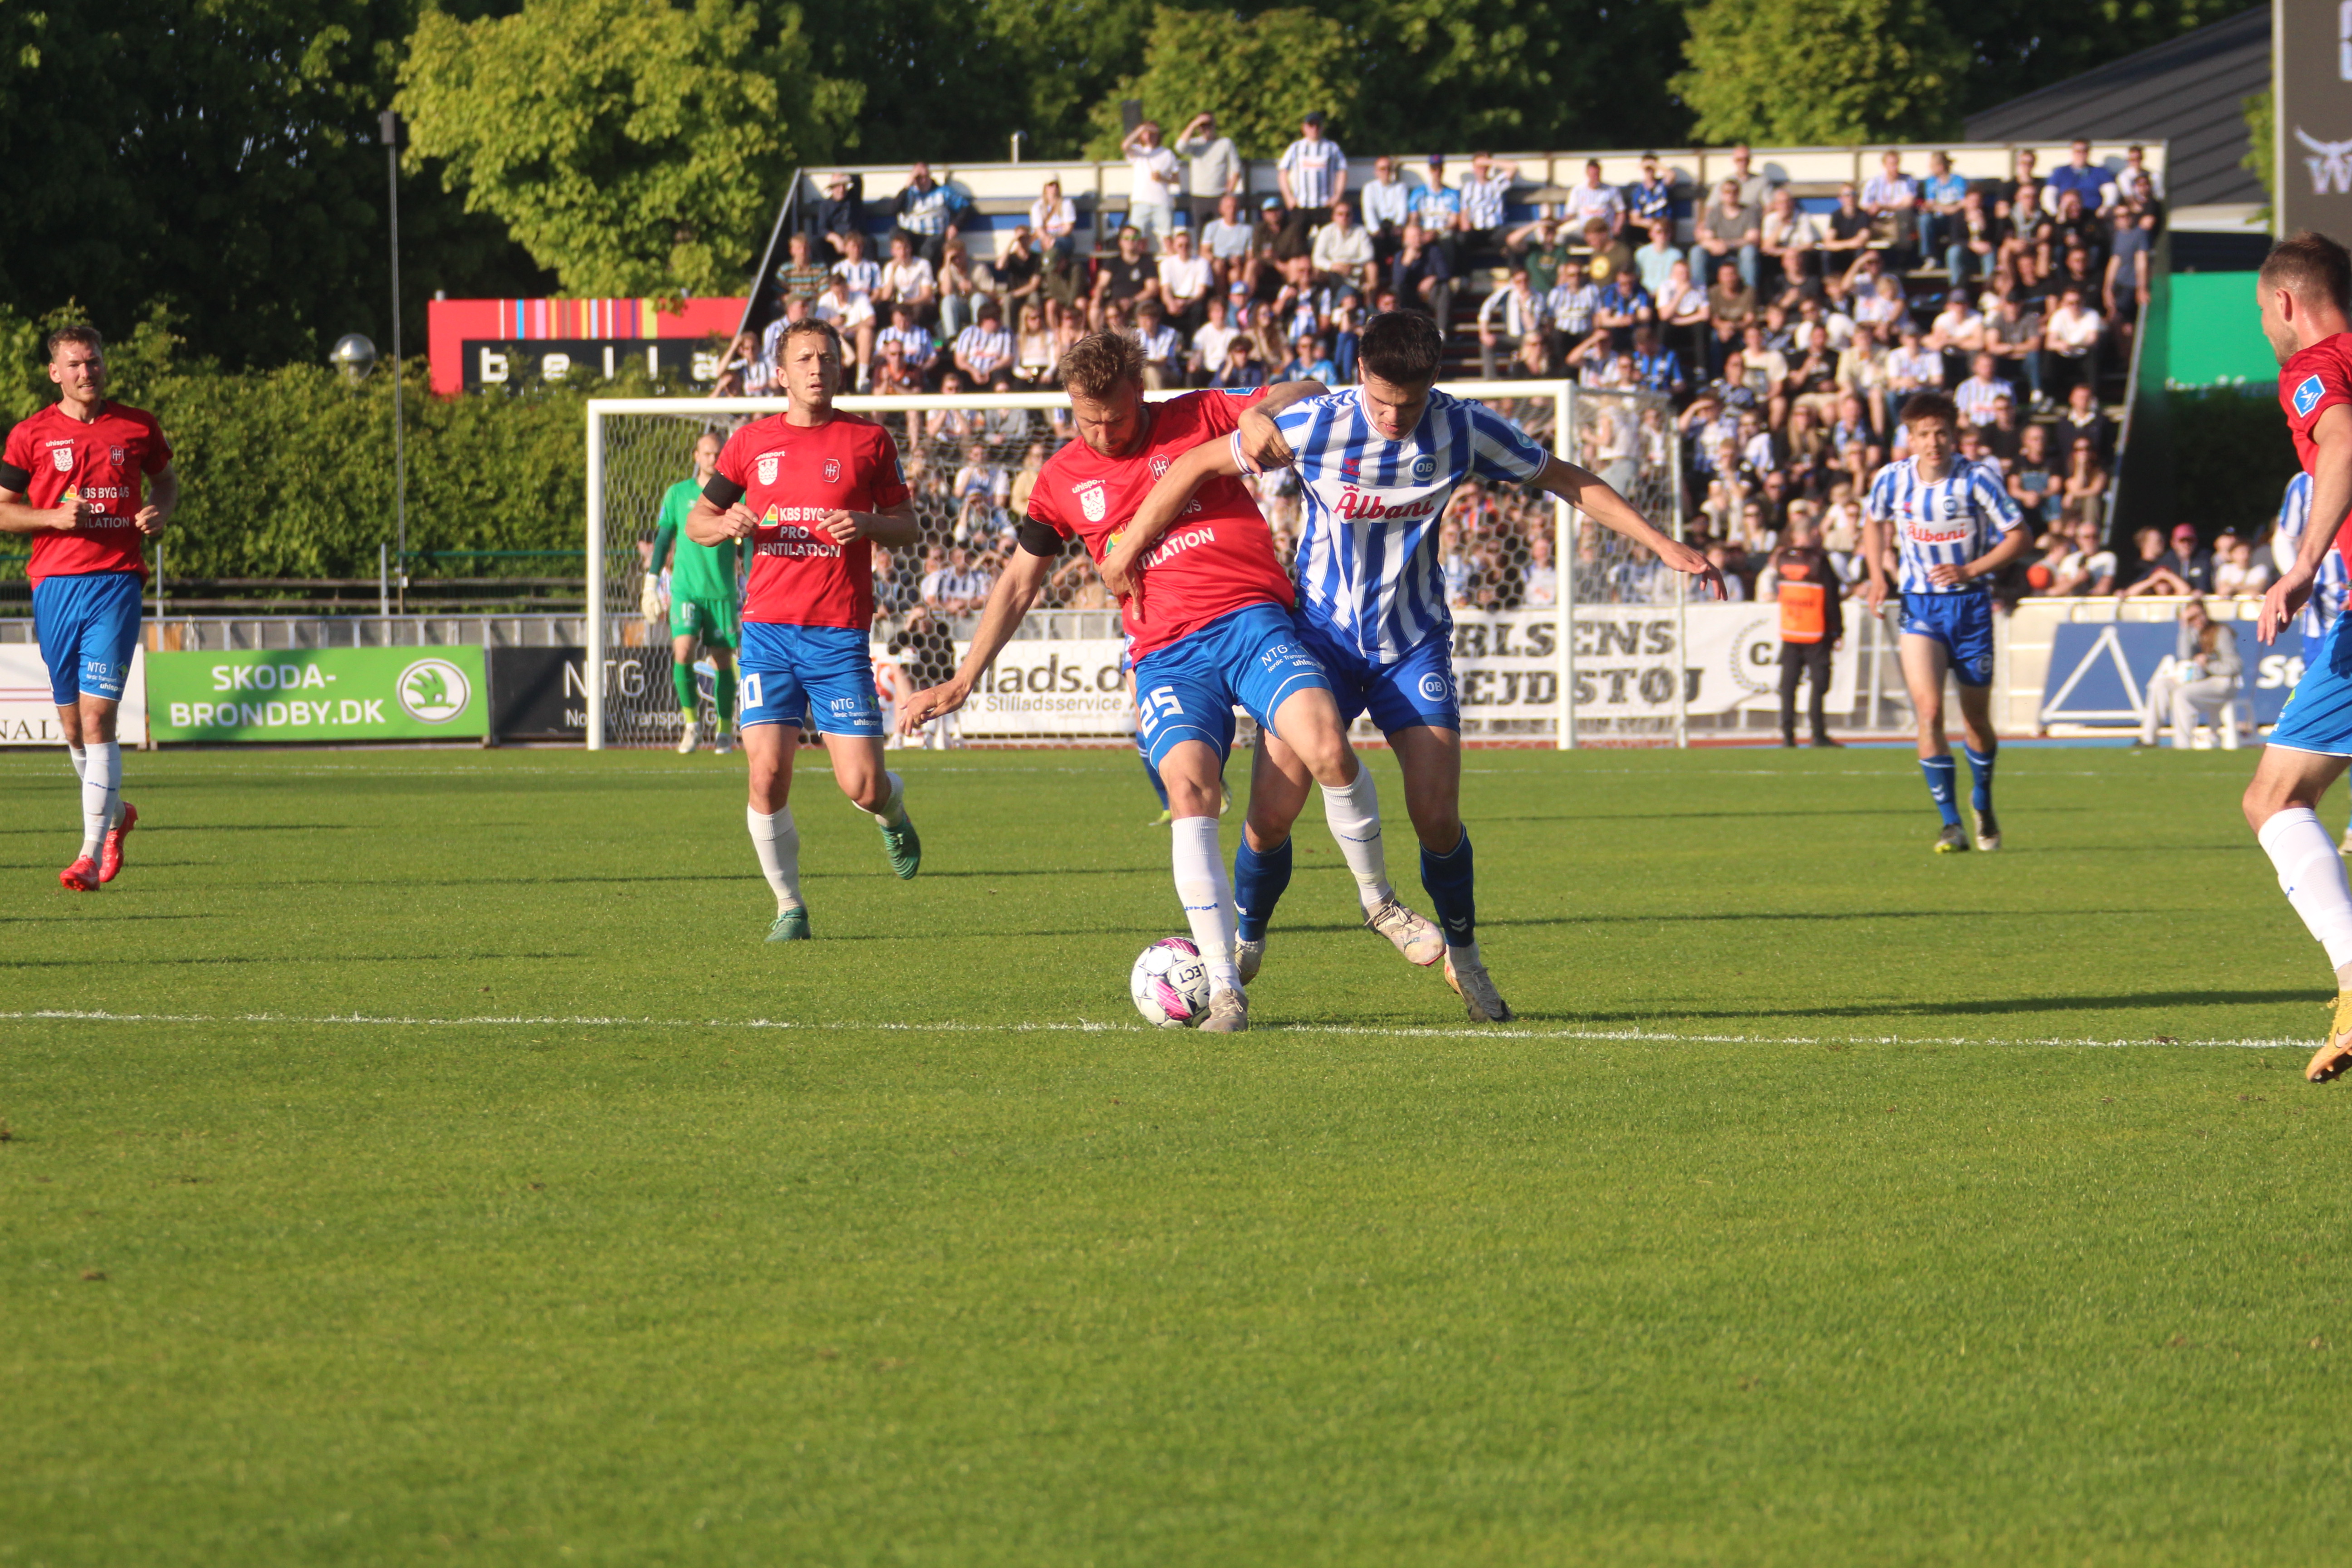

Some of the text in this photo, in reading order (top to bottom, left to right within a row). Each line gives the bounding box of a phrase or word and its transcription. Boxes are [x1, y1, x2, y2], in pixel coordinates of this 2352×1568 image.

[480, 346, 720, 383] bella
[46, 438, 74, 447] uhlsport
[1416, 463, 1433, 473] OB
[79, 487, 96, 498] KBS
[98, 487, 118, 498] BYG
[1072, 479, 1106, 494] uhlsport
[88, 502, 105, 514] RO
[1333, 492, 1436, 519] Albani
[779, 507, 801, 521] KBS
[780, 526, 809, 539] PRO
[1907, 523, 1967, 542] Albani
[1136, 527, 1215, 570] TILATION
[1261, 644, 1288, 666] NTG
[87, 661, 107, 674] NTG
[1267, 658, 1284, 673] Nordic
[212, 664, 336, 691] SKODA-
[1425, 681, 1443, 693] OB
[831, 698, 854, 711] NTG
[986, 695, 1122, 711] Stilladsservice
[170, 699, 386, 727] BRONDBY.DK
[1140, 686, 1184, 739] 25
